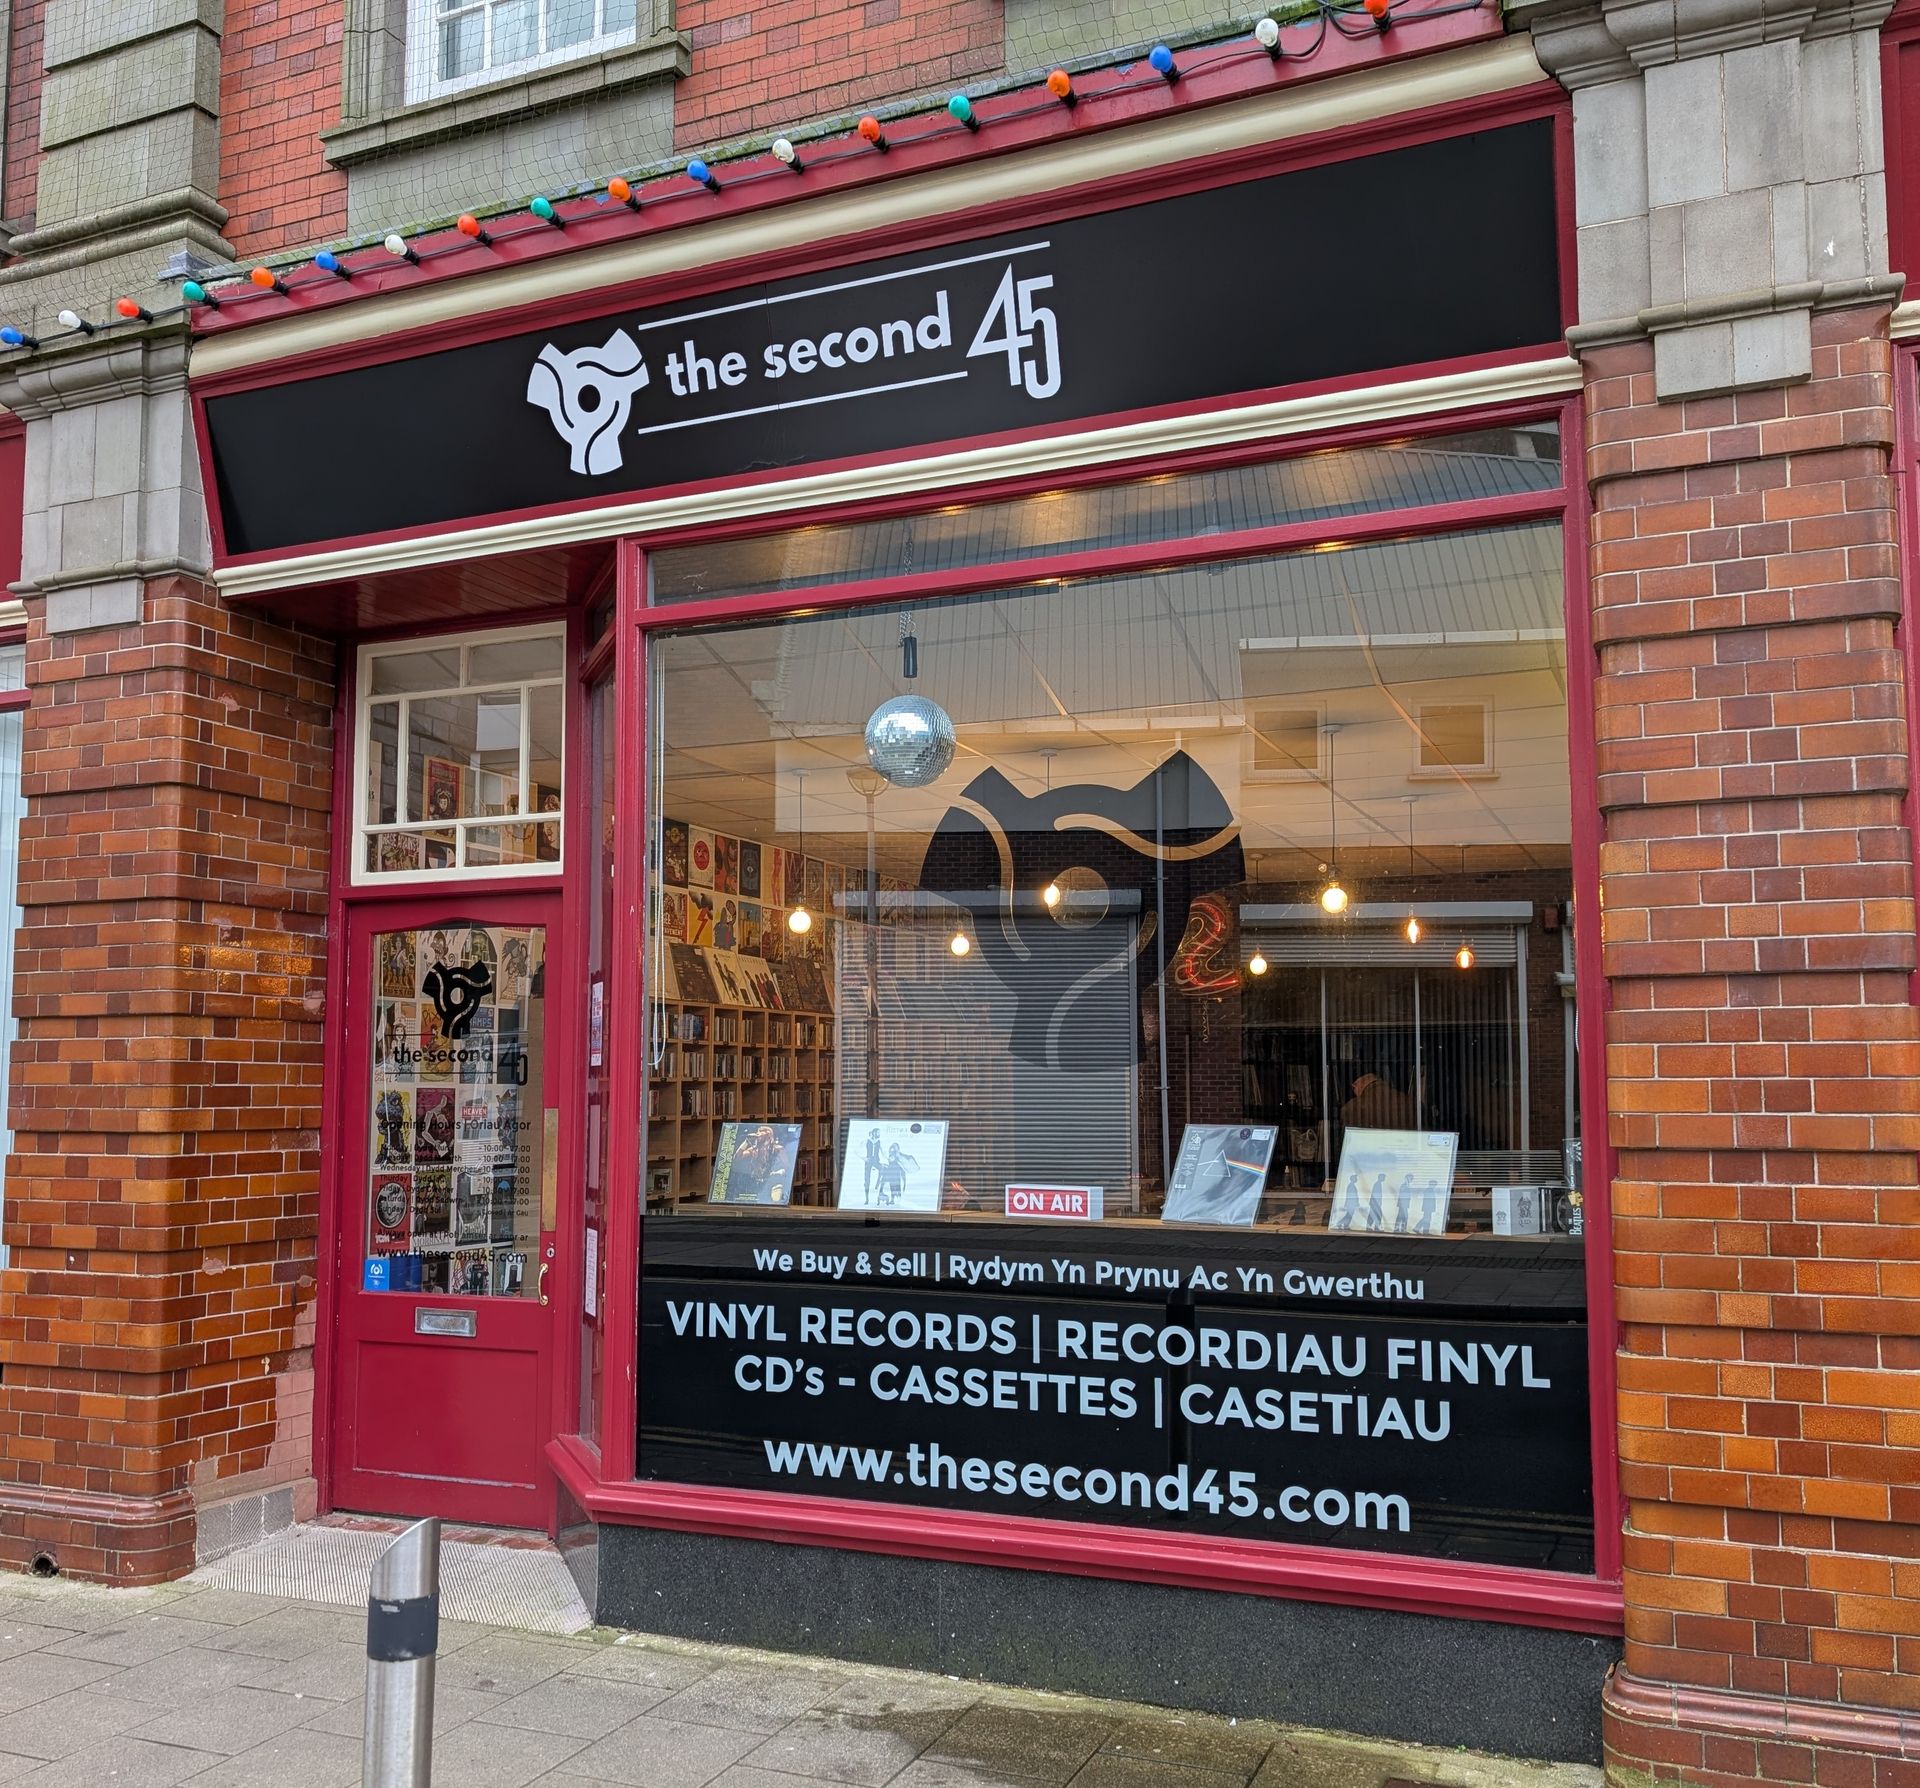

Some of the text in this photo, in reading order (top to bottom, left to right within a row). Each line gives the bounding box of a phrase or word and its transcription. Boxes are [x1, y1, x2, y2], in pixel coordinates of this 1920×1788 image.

[665, 263, 1061, 398] the second 45
[393, 1043, 422, 1062] the
[429, 1045, 493, 1062] second
[431, 1119, 461, 1130] Hours
[503, 1120, 531, 1133] Agor
[381, 1165, 420, 1174] Wednesday
[1012, 1192, 1083, 1213] ON AIR
[377, 1246, 528, 1264] www.thesecond45.com
[753, 1249, 793, 1272] We
[801, 1250, 848, 1280] Buy
[855, 1251, 873, 1275] &
[880, 1252, 927, 1277] Sell
[949, 1255, 1044, 1287] Rydym
[1051, 1258, 1086, 1284] Yn
[1096, 1261, 1180, 1293] Prynu
[1187, 1266, 1229, 1291] Ac
[1236, 1267, 1274, 1293] Yn
[1284, 1270, 1424, 1300] Gwerthu
[667, 1301, 787, 1342] VINYL
[801, 1307, 1017, 1355] RECORDS
[1058, 1319, 1366, 1377] RECORDIAU
[1388, 1338, 1551, 1389] FINYL
[735, 1355, 825, 1396] CD's
[870, 1362, 1137, 1418] CASSETTES
[1180, 1383, 1450, 1442] CASETIAU
[764, 1440, 1410, 1532] www.thesecond45.com
